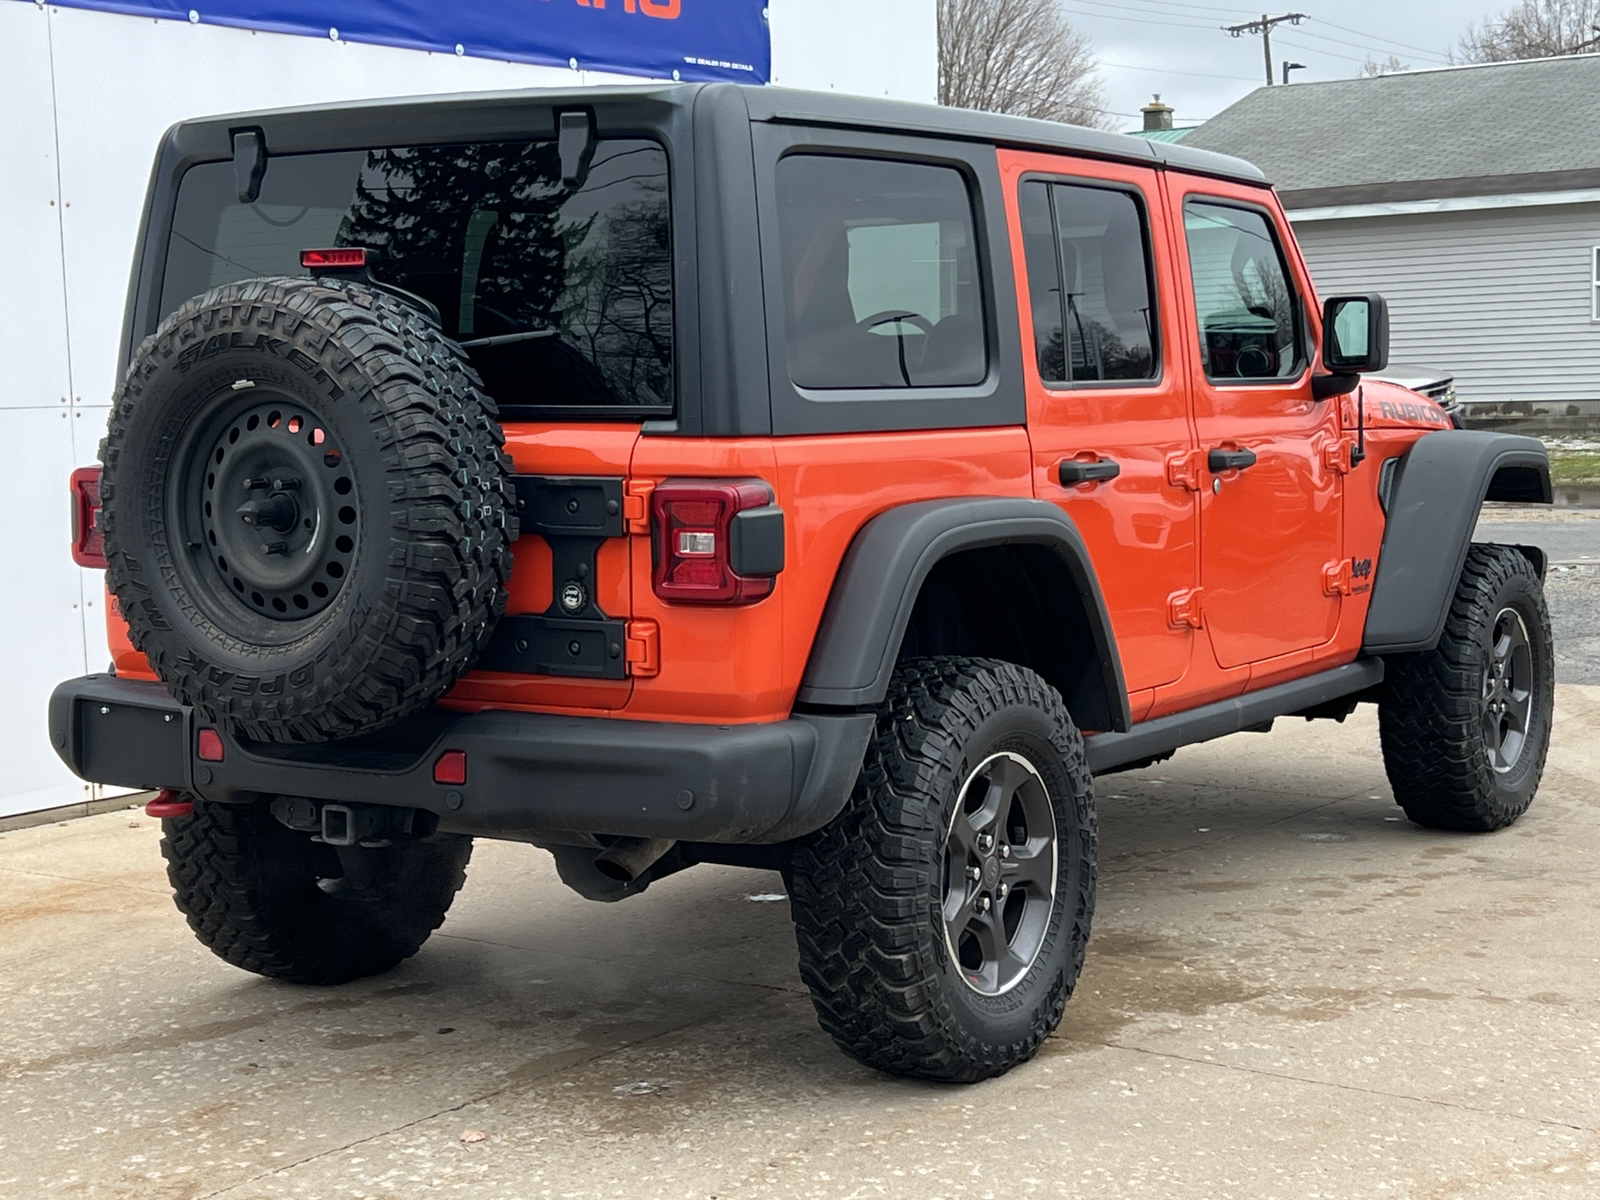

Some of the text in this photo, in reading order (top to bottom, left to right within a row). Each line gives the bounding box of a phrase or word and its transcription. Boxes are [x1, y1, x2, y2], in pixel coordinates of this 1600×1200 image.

[697, 58, 719, 67] DEALER
[731, 62, 754, 72] DETAILS
[172, 330, 345, 402] FALKEN
[1379, 401, 1452, 424] RUBICON
